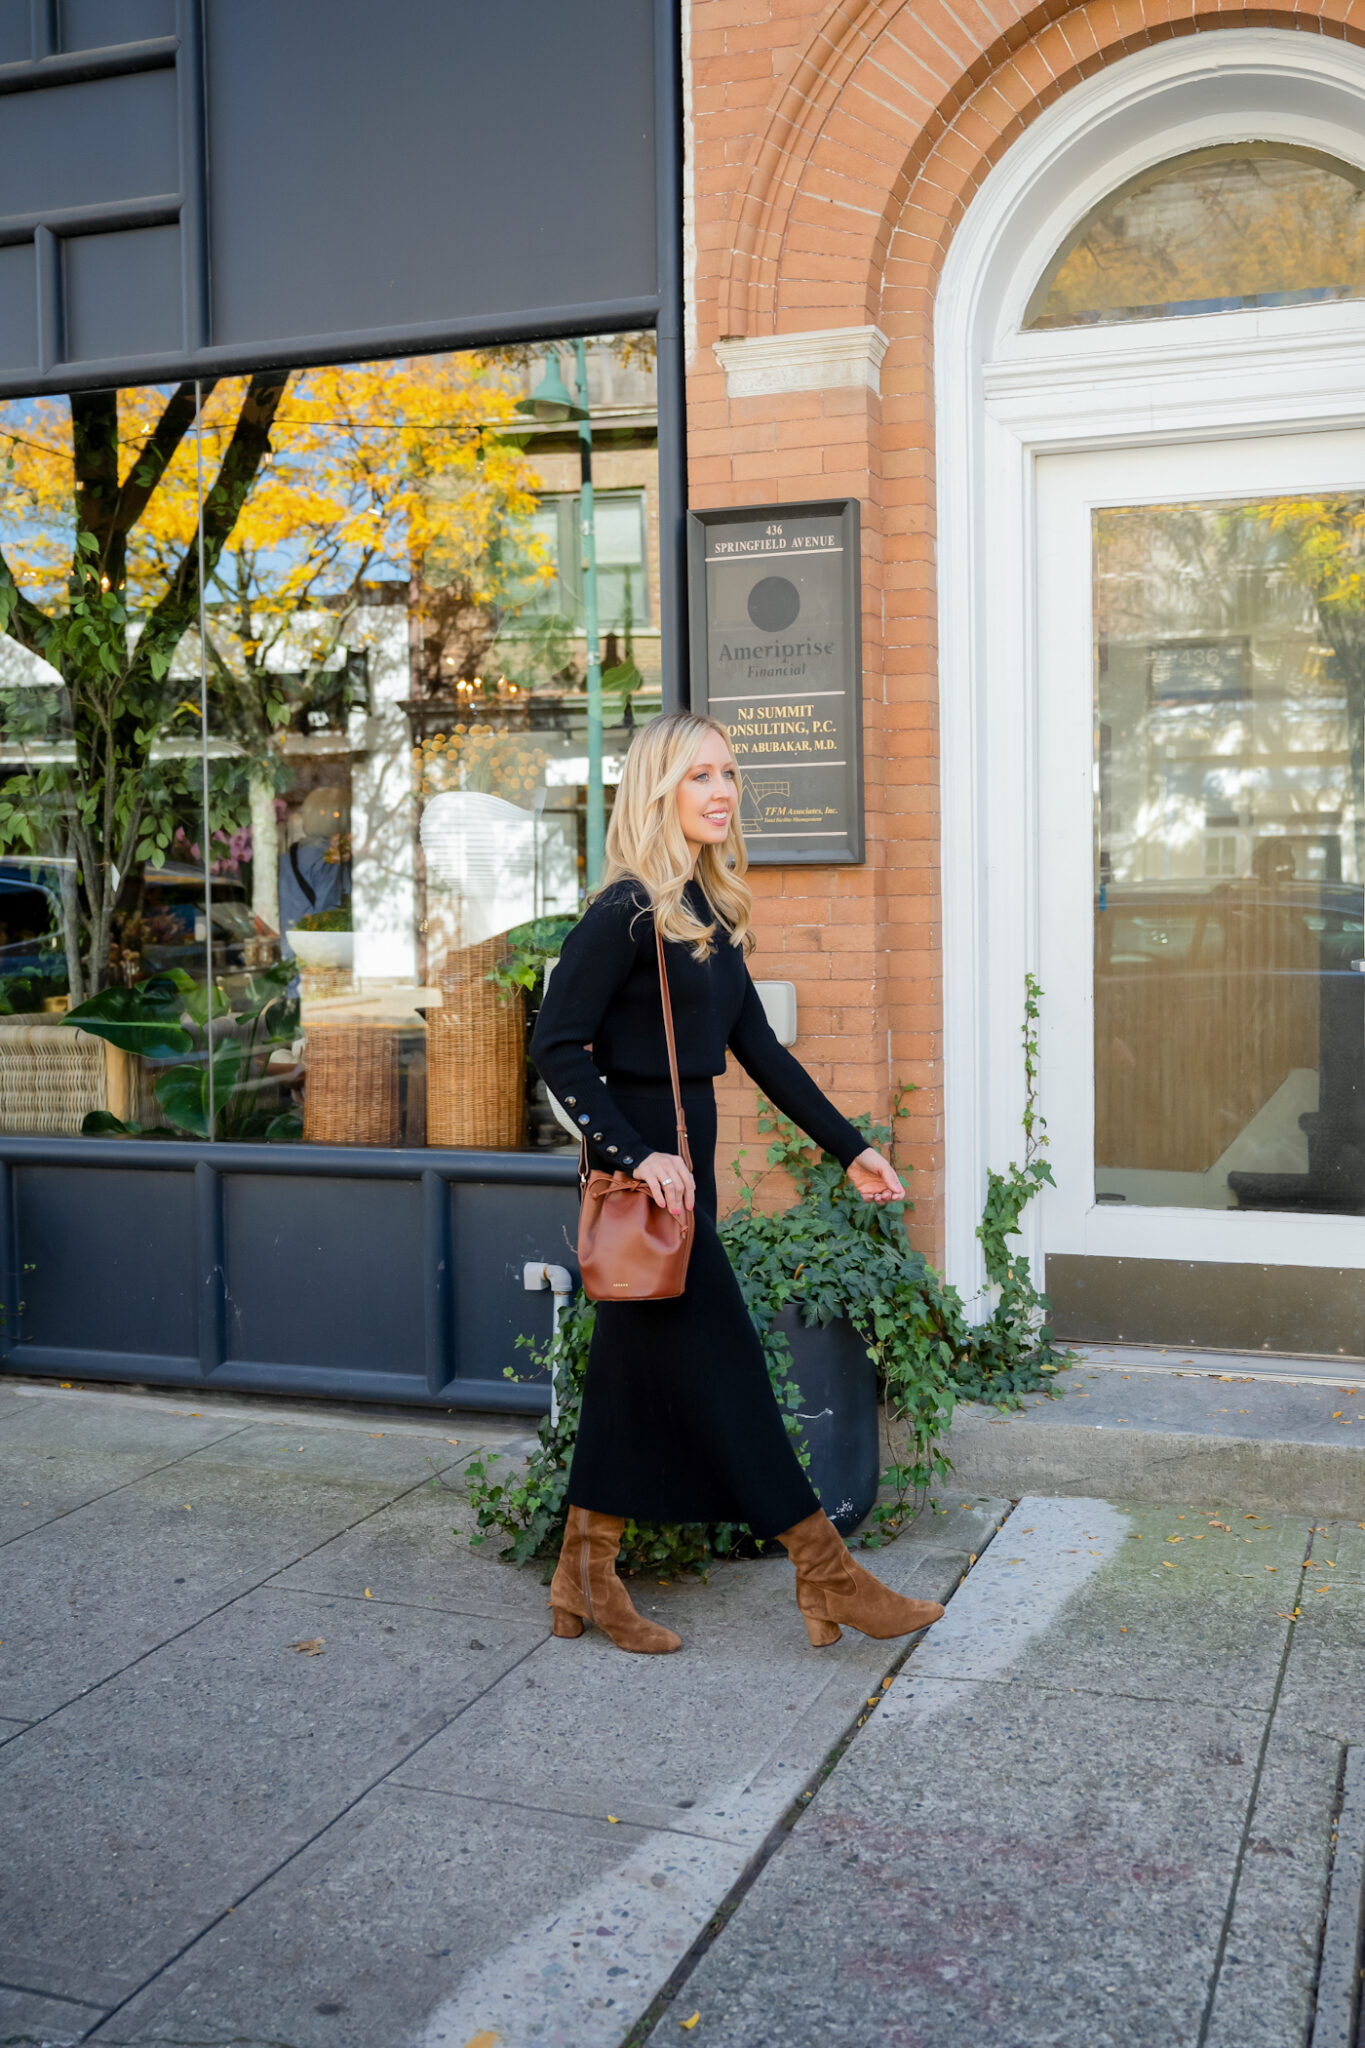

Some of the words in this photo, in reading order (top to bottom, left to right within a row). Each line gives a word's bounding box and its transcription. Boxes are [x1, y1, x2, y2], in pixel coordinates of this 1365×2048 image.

[766, 524, 783, 536] 436
[715, 539, 786, 553] SPRINGFIELD
[791, 535, 835, 548] AVENUE
[719, 638, 835, 663] Ameriprise
[1179, 648, 1220, 667] 436
[747, 663, 806, 679] Financial
[737, 708, 754, 720] NJ
[757, 705, 814, 719] SUMMIT
[727, 722, 809, 736] ONSULTING,
[812, 720, 837, 733] P.C.
[751, 741, 812, 752] ABUBAKAR,
[814, 739, 837, 750] M.D.
[764, 806, 787, 816] TFM
